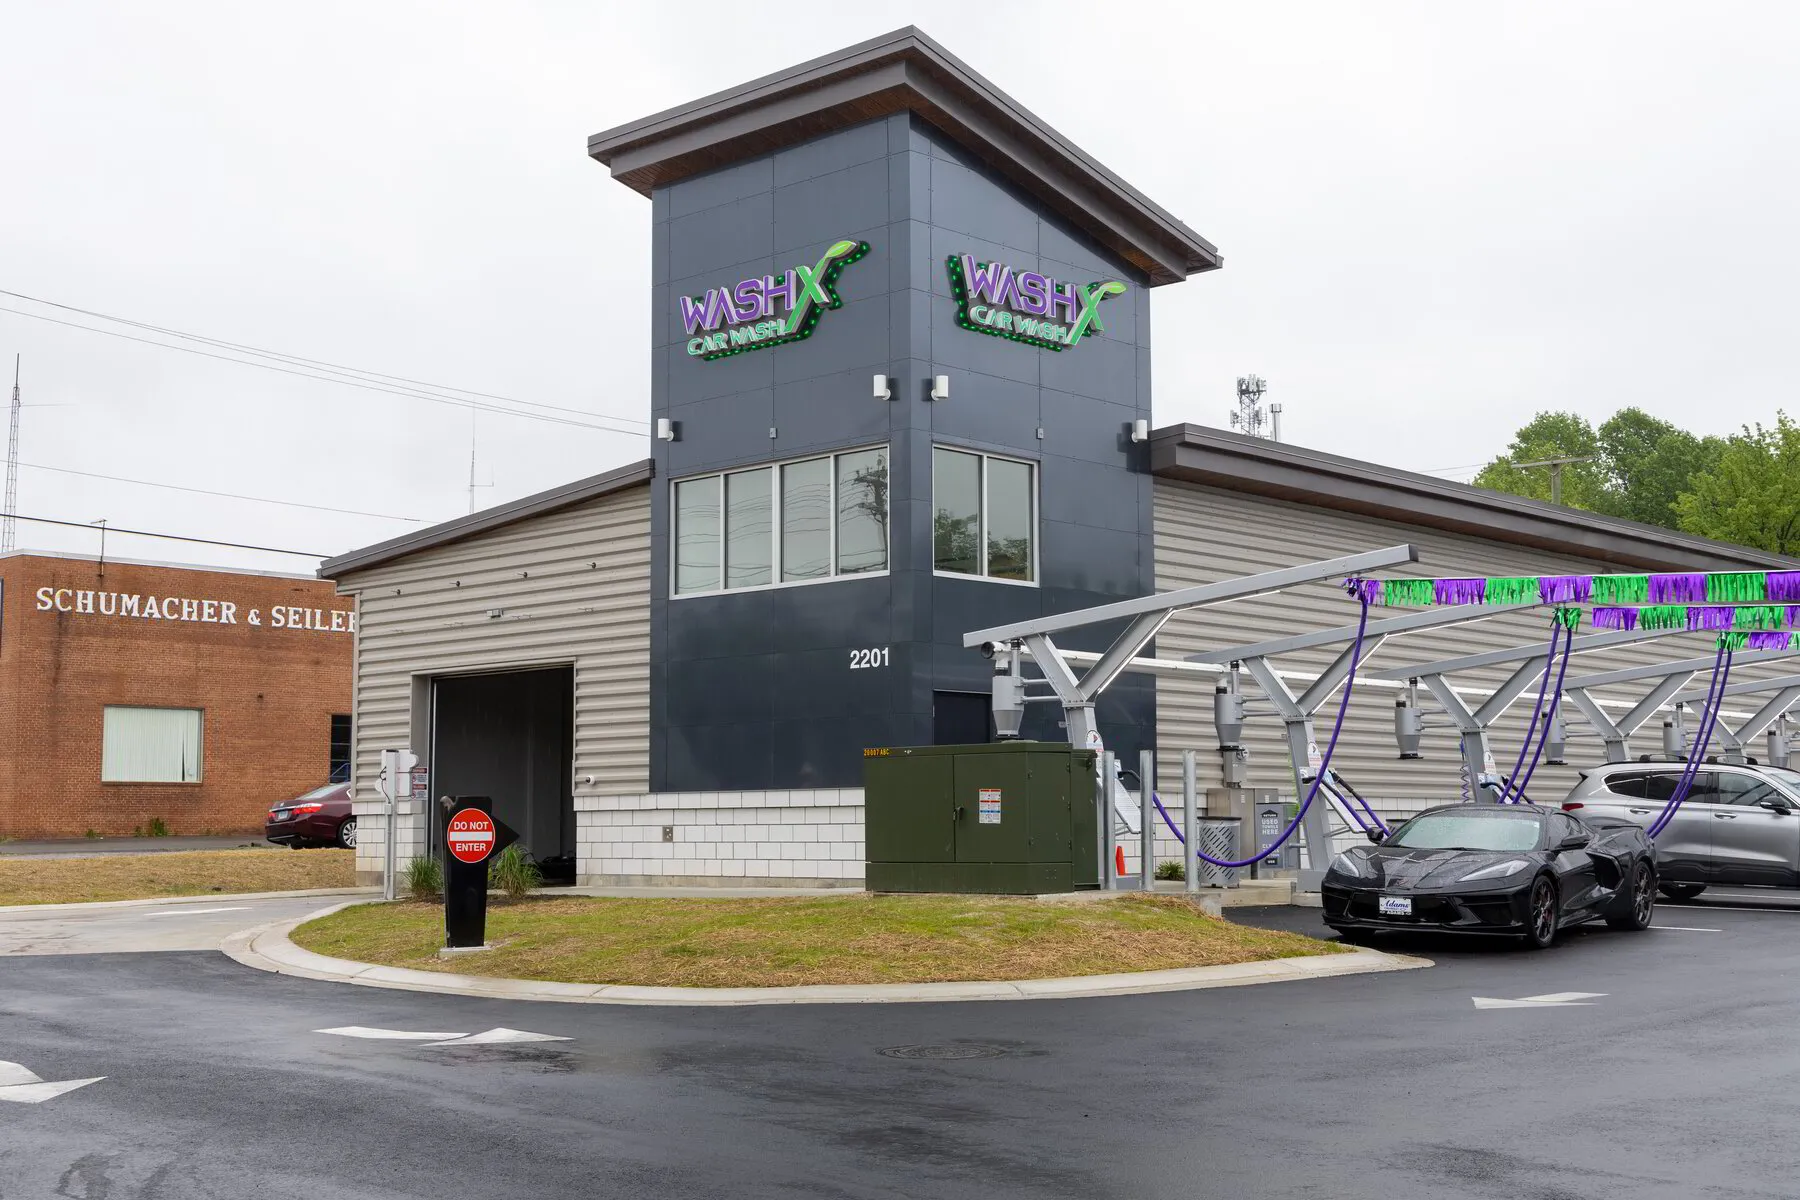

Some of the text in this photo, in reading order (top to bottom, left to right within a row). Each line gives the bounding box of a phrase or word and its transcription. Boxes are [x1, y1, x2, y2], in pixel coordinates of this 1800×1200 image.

[680, 240, 857, 334] WASHX
[960, 254, 1128, 346] WASHX
[687, 318, 786, 356] CAR WASH
[970, 305, 1068, 343] CAR WASH
[36, 587, 237, 624] SCHUMACHER
[247, 609, 262, 626] &
[850, 647, 889, 669] 2201
[453, 821, 489, 831] DO NOT
[455, 843, 486, 852] ENTER
[1381, 900, 1409, 908] Adams
